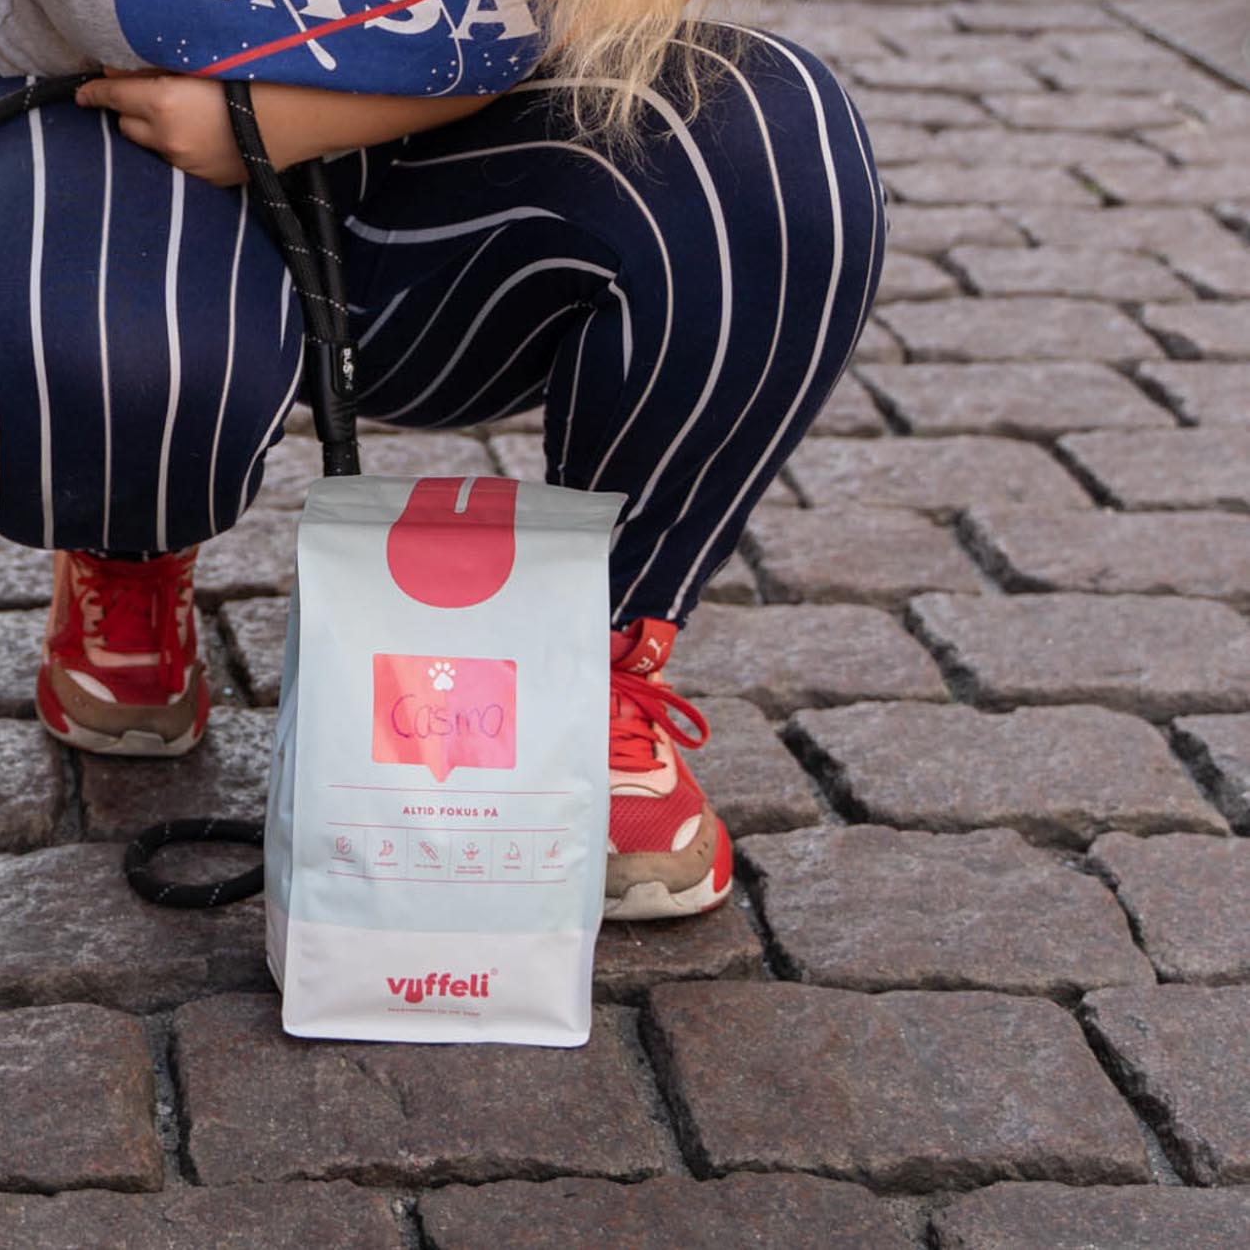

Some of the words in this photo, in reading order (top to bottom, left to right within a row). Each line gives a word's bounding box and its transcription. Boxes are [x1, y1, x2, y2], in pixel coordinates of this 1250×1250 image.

[402, 805, 435, 816] ALTID
[439, 806, 479, 817] FOKUS
[483, 805, 499, 817] PÅ
[386, 972, 489, 1004] vuffeli
